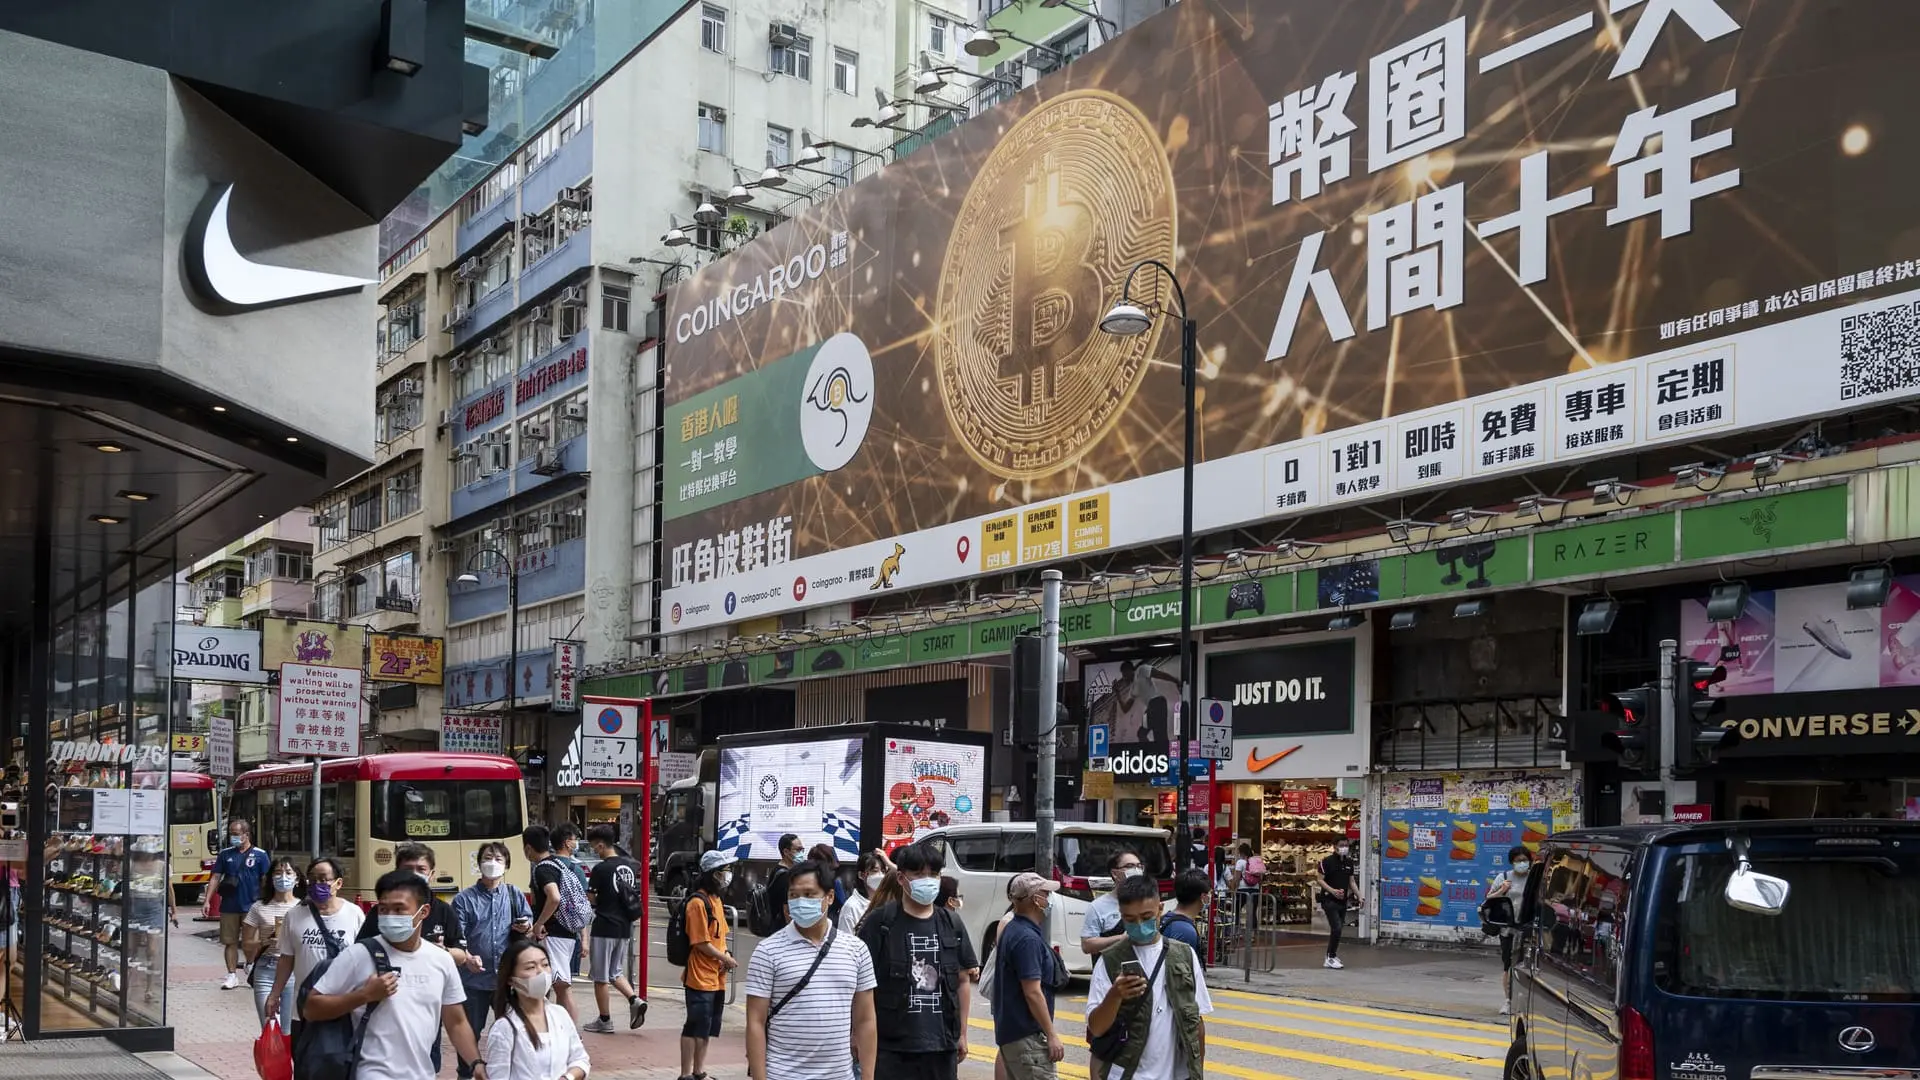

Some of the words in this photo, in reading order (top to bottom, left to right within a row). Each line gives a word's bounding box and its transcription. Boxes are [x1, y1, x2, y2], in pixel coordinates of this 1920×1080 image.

[1265, 88, 1741, 363] 人間十年
[676, 243, 827, 344] COINGAROO
[1659, 299, 1760, 340] 如有任何爭議
[1657, 358, 1724, 404] 定期
[1565, 382, 1626, 423] 專車
[1482, 402, 1537, 443] 免費
[1658, 404, 1722, 431] 會員活動
[1405, 421, 1456, 459] 即時
[1566, 423, 1624, 449] 接送服務
[680, 437, 737, 473] 一對一教學
[1332, 440, 1381, 473] 1對1
[1482, 442, 1535, 467] 新手講座
[1336, 475, 1380, 496] 專人教學
[1277, 491, 1307, 507] 手續費
[671, 515, 793, 588] 旺角波鞋街
[1554, 531, 1650, 563] RAZER
[811, 575, 843, 590] coingaroo
[685, 603, 710, 615] coingaroo
[923, 634, 955, 652] START
[1059, 614, 1092, 633] HERE
[380, 652, 411, 674] 2F
[305, 668, 338, 679] Vehicle
[289, 677, 322, 689] waiting
[325, 680, 341, 688] will
[342, 681, 353, 689] be
[1088, 684, 1113, 695] adidas
[1232, 681, 1272, 707] JUST
[1275, 679, 1302, 702] DO
[1304, 677, 1326, 701] IT.
[284, 695, 321, 705] without
[321, 699, 357, 709] warning
[296, 687, 346, 699] prosecuted
[295, 708, 346, 722] 停車等候
[295, 724, 345, 737] 會被檢控
[1220, 728, 1227, 739] 7
[176, 736, 201, 748] 士多
[287, 737, 351, 752] 而不予警告
[617, 741, 626, 754] 7
[1092, 728, 1105, 755] P
[1221, 746, 1231, 758] 12
[584, 760, 613, 768] midnight
[617, 763, 633, 777] 12
[1673, 812, 1703, 820] UMMER
[1671, 1061, 1726, 1072] LEXUS
